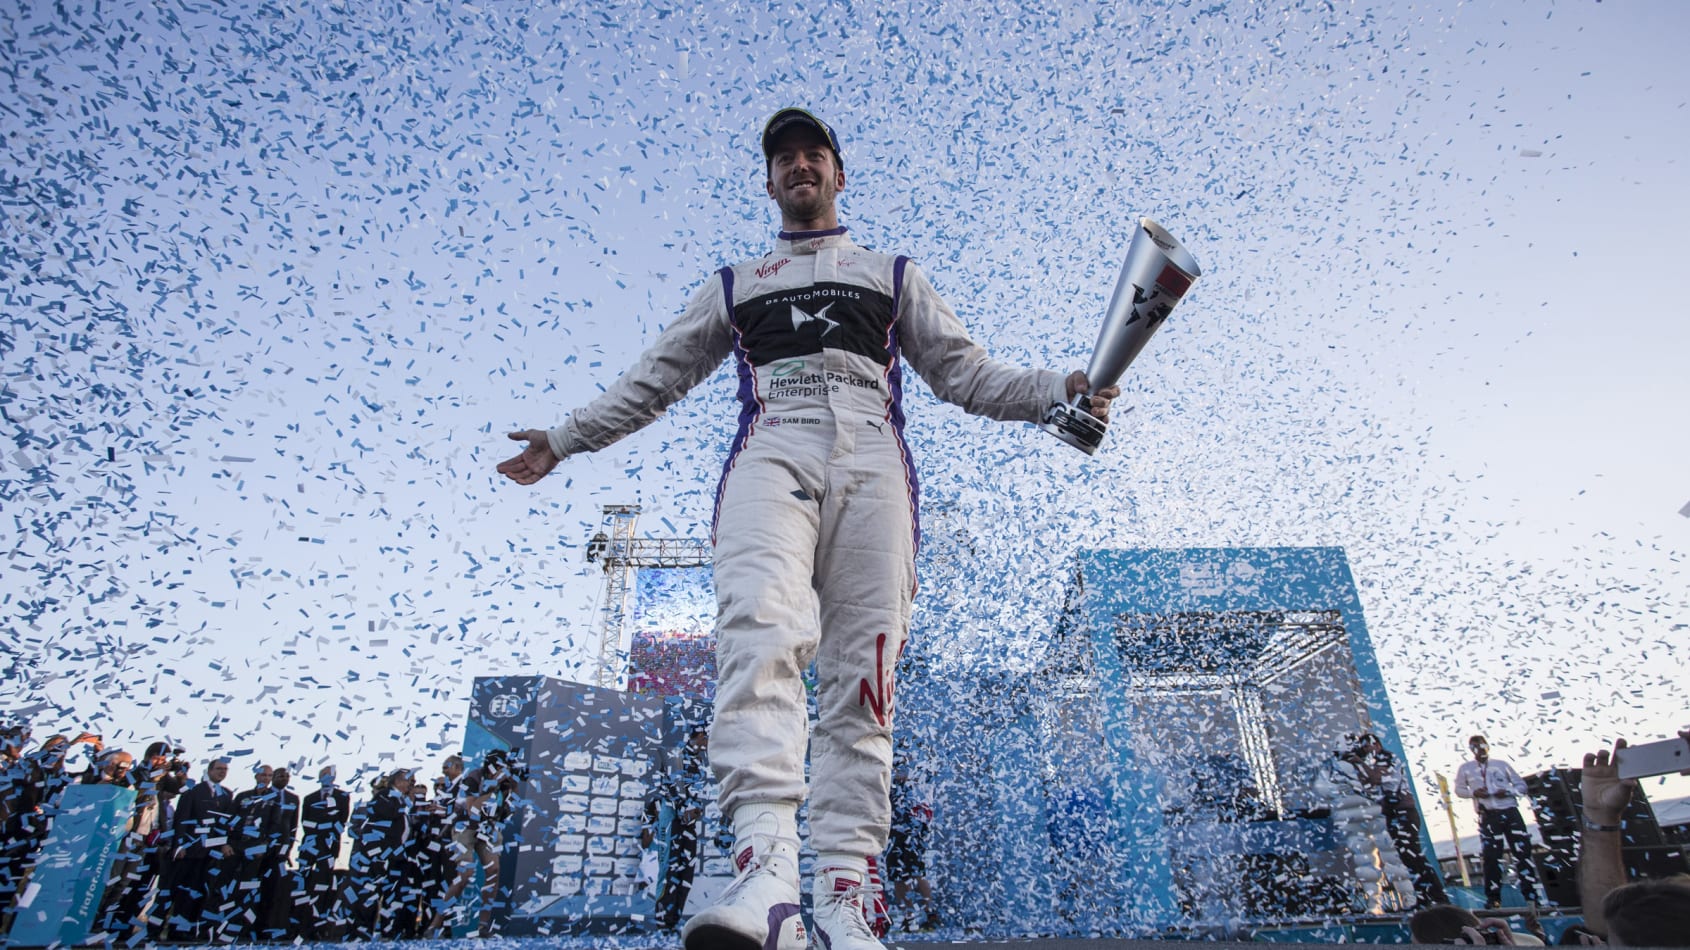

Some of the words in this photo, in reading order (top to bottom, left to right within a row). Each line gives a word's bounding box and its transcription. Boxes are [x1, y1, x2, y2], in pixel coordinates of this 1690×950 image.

[755, 257, 792, 279] Virgin
[782, 289, 860, 302] AUTOMOBILES
[769, 373, 824, 389] Hewlett
[826, 372, 879, 389] Packard
[768, 384, 840, 400] Enterprise
[782, 417, 799, 425] SAM
[801, 417, 821, 425] BIRD
